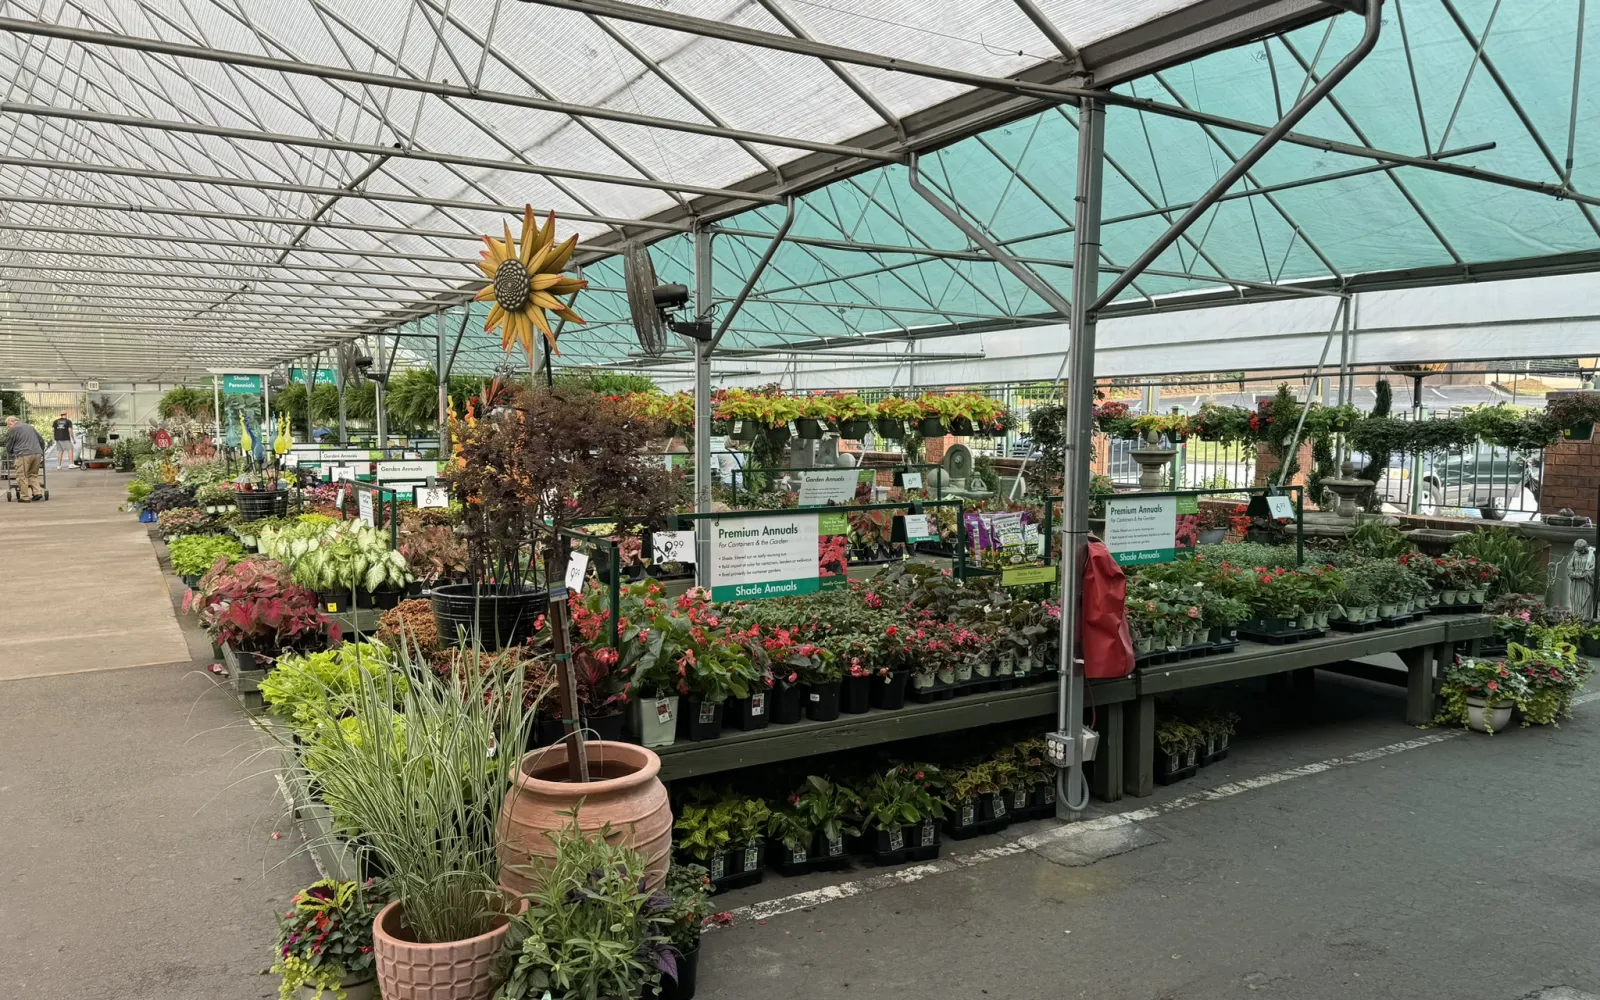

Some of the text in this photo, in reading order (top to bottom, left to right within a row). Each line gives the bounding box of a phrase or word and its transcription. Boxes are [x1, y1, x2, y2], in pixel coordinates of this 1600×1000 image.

[1110, 503, 1163, 516] Premium Annuals
[718, 523, 798, 538] Premium Annuals
[718, 541, 727, 549] For
[727, 539, 755, 548] Containers
[1119, 550, 1160, 562] Shade Annuals
[735, 581, 798, 597] Shade Annuals
